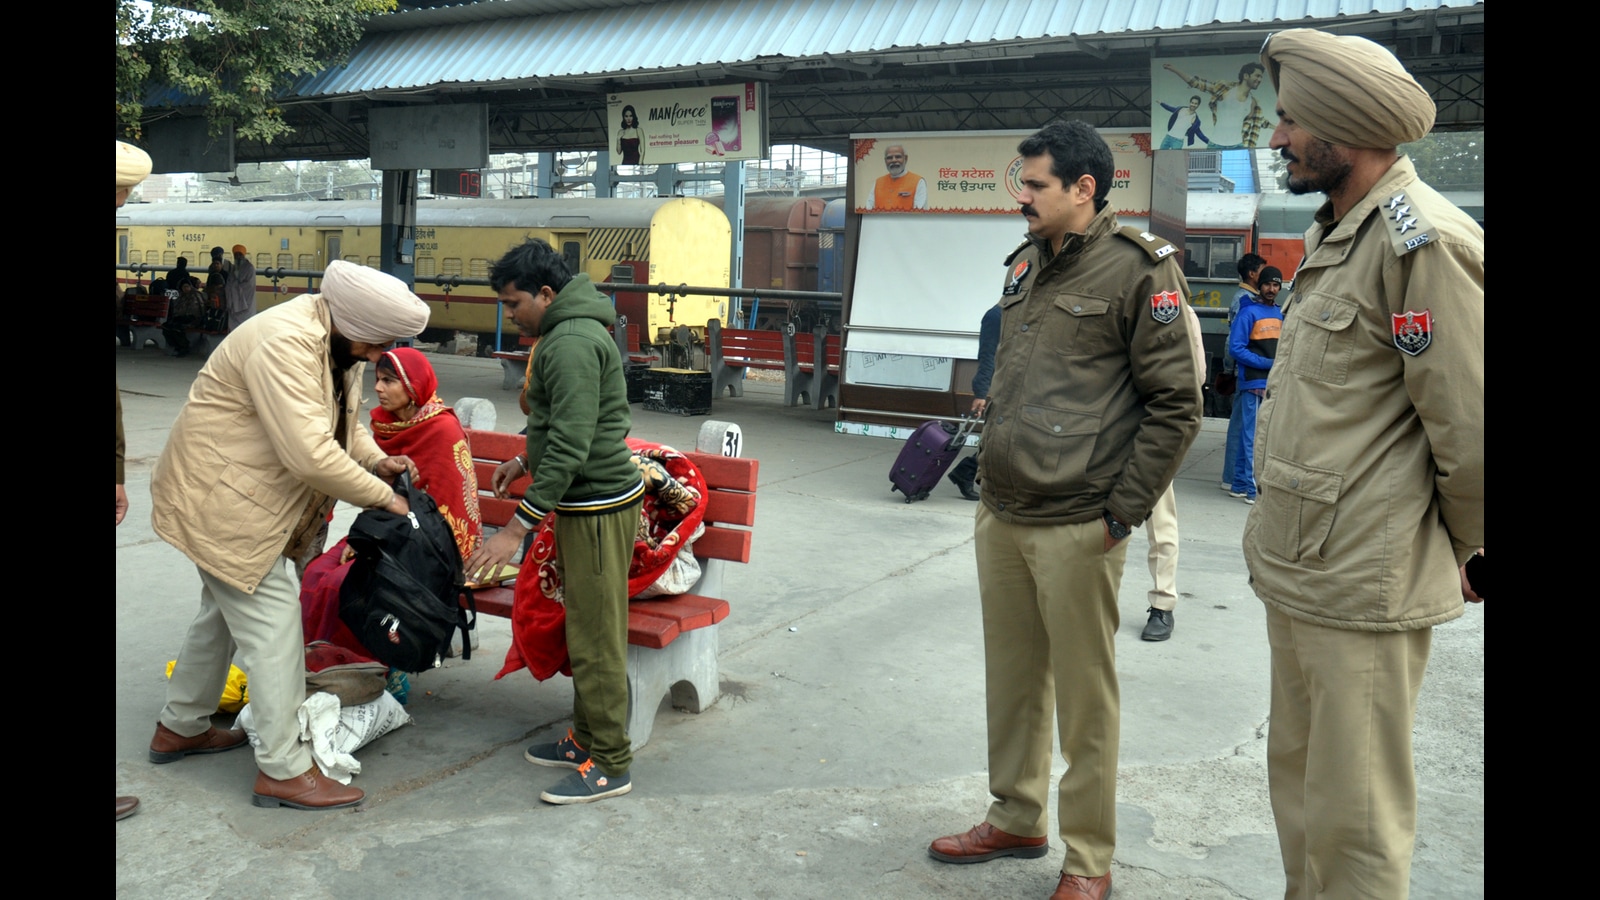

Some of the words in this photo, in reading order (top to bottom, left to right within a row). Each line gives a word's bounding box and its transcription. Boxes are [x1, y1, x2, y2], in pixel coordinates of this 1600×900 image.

[674, 138, 699, 147] pleasure
[1115, 169, 1130, 178] ON
[1111, 180, 1130, 189] UCT
[182, 233, 206, 242] 143567
[167, 240, 176, 249] NR
[1188, 290, 1221, 307] 48
[724, 431, 739, 458] 31
